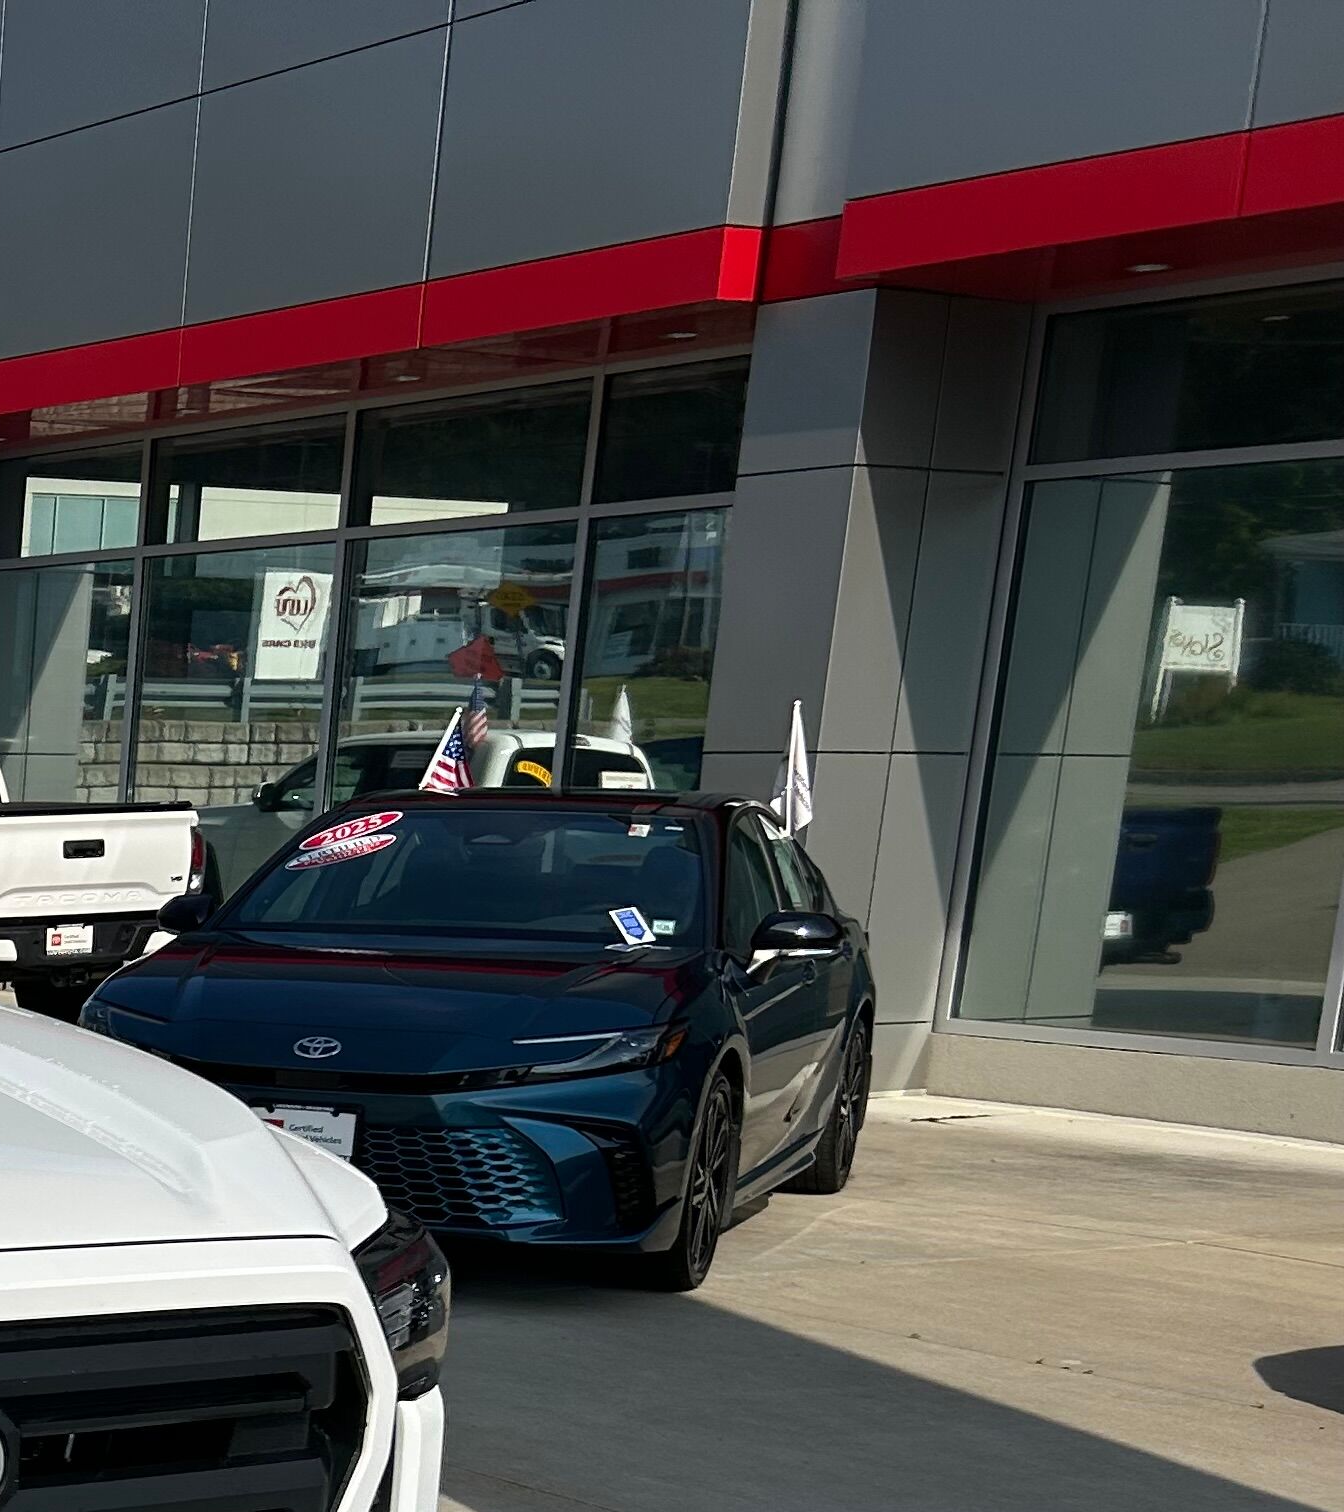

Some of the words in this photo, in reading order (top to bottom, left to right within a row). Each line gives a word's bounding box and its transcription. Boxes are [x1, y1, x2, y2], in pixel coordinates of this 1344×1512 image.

[319, 815, 383, 846] 2025
[13, 890, 142, 905] TACOMA
[289, 1124, 324, 1133] Certified
